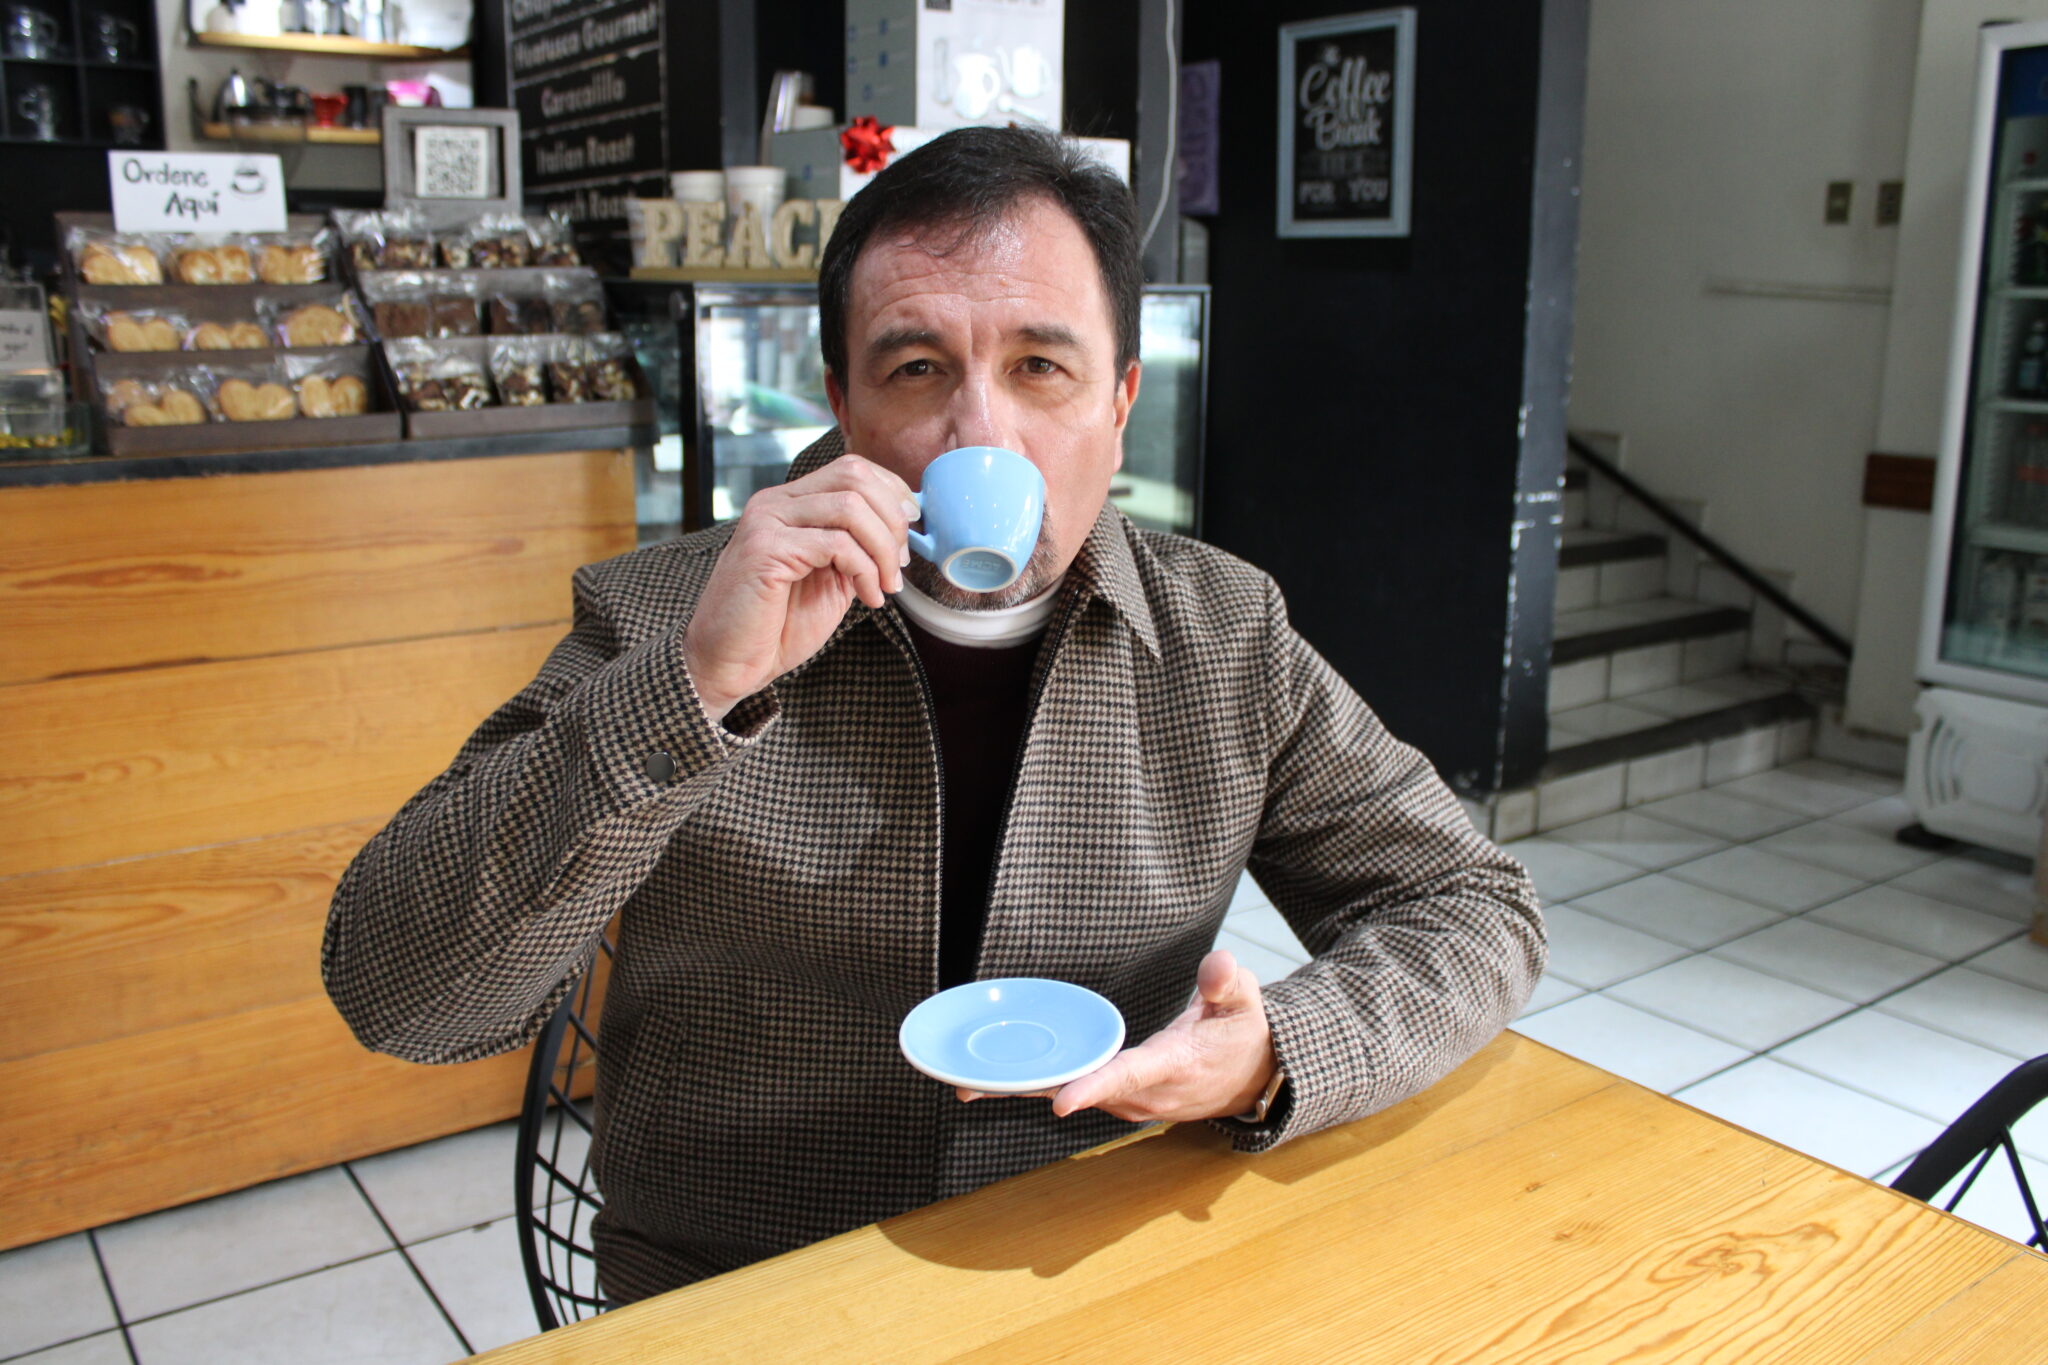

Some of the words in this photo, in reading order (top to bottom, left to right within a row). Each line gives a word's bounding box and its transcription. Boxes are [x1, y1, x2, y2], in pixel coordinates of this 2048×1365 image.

[582, 2, 658, 49] Gourmet
[1301, 56, 1391, 121] Coffee
[1304, 106, 1382, 150] Break
[122, 157, 209, 188] Ordene
[536, 139, 584, 176] Italian
[586, 133, 636, 168] Roast
[1299, 180, 1335, 204] FOR
[1348, 177, 1389, 202] YOU
